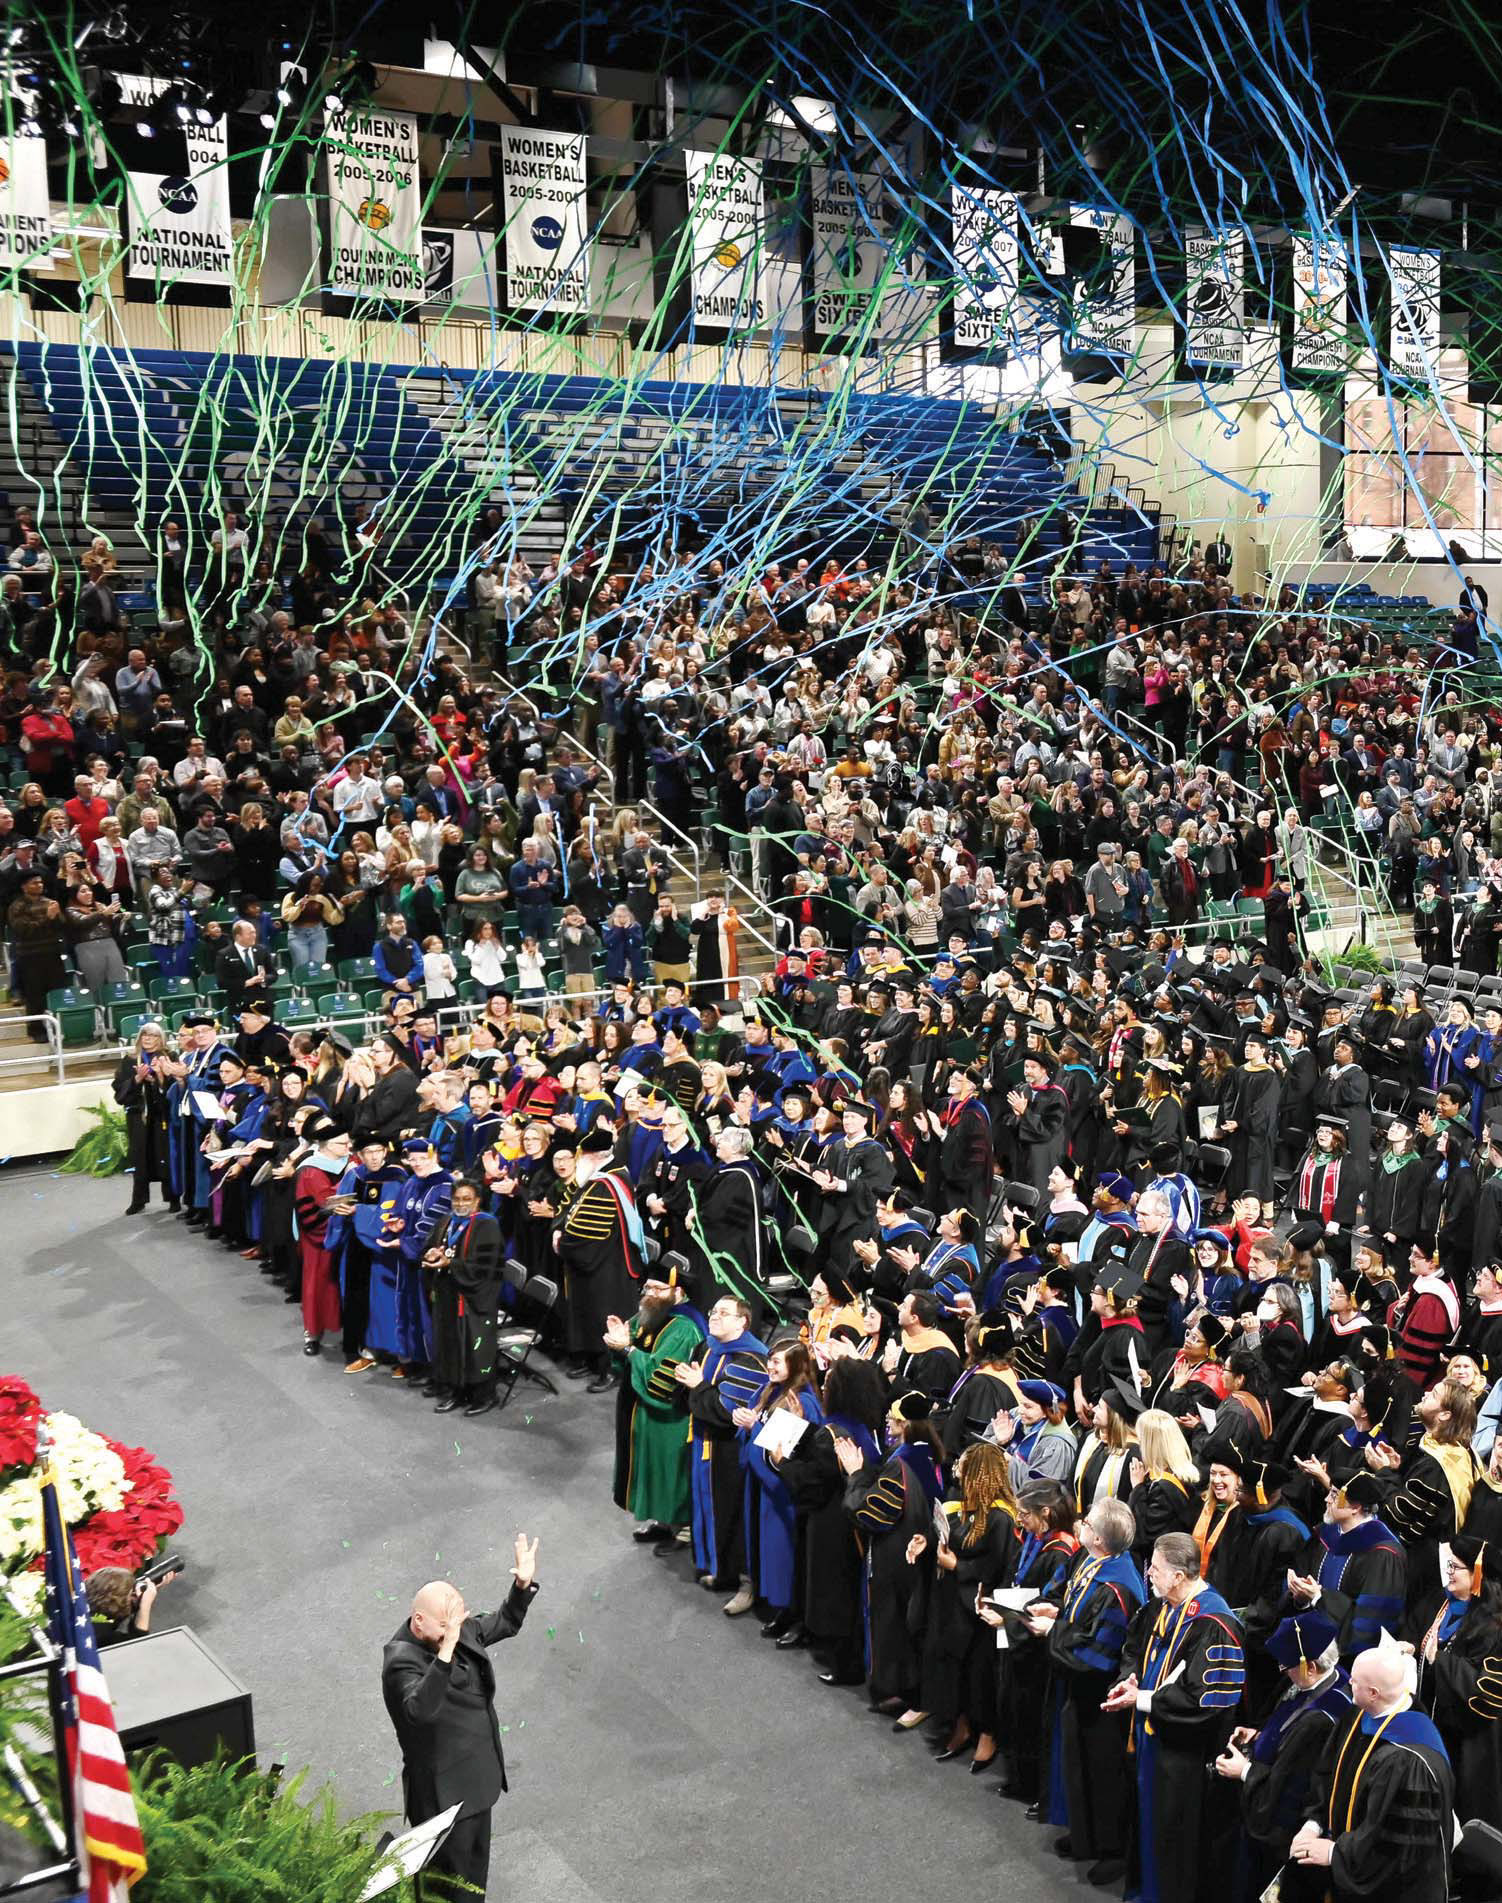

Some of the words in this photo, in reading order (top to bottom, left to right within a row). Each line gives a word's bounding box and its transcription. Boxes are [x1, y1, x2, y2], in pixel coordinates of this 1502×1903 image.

[333, 115, 410, 140] WOMEN'S
[508, 137, 579, 161] WOMEN'S
[504, 159, 585, 184] BASKETBALL
[956, 194, 1014, 214] WOEN'S
[137, 227, 226, 250] NATIONAL
[132, 244, 231, 272] TOURNAMENT
[334, 264, 423, 290] CHAMPIONS
[516, 264, 583, 284] NATIONAL
[511, 279, 585, 302] TOURNAMENT
[695, 294, 764, 320] CHAMPOS
[1203, 333, 1225, 346] NCAA
[1192, 347, 1241, 361] OURNAMENT
